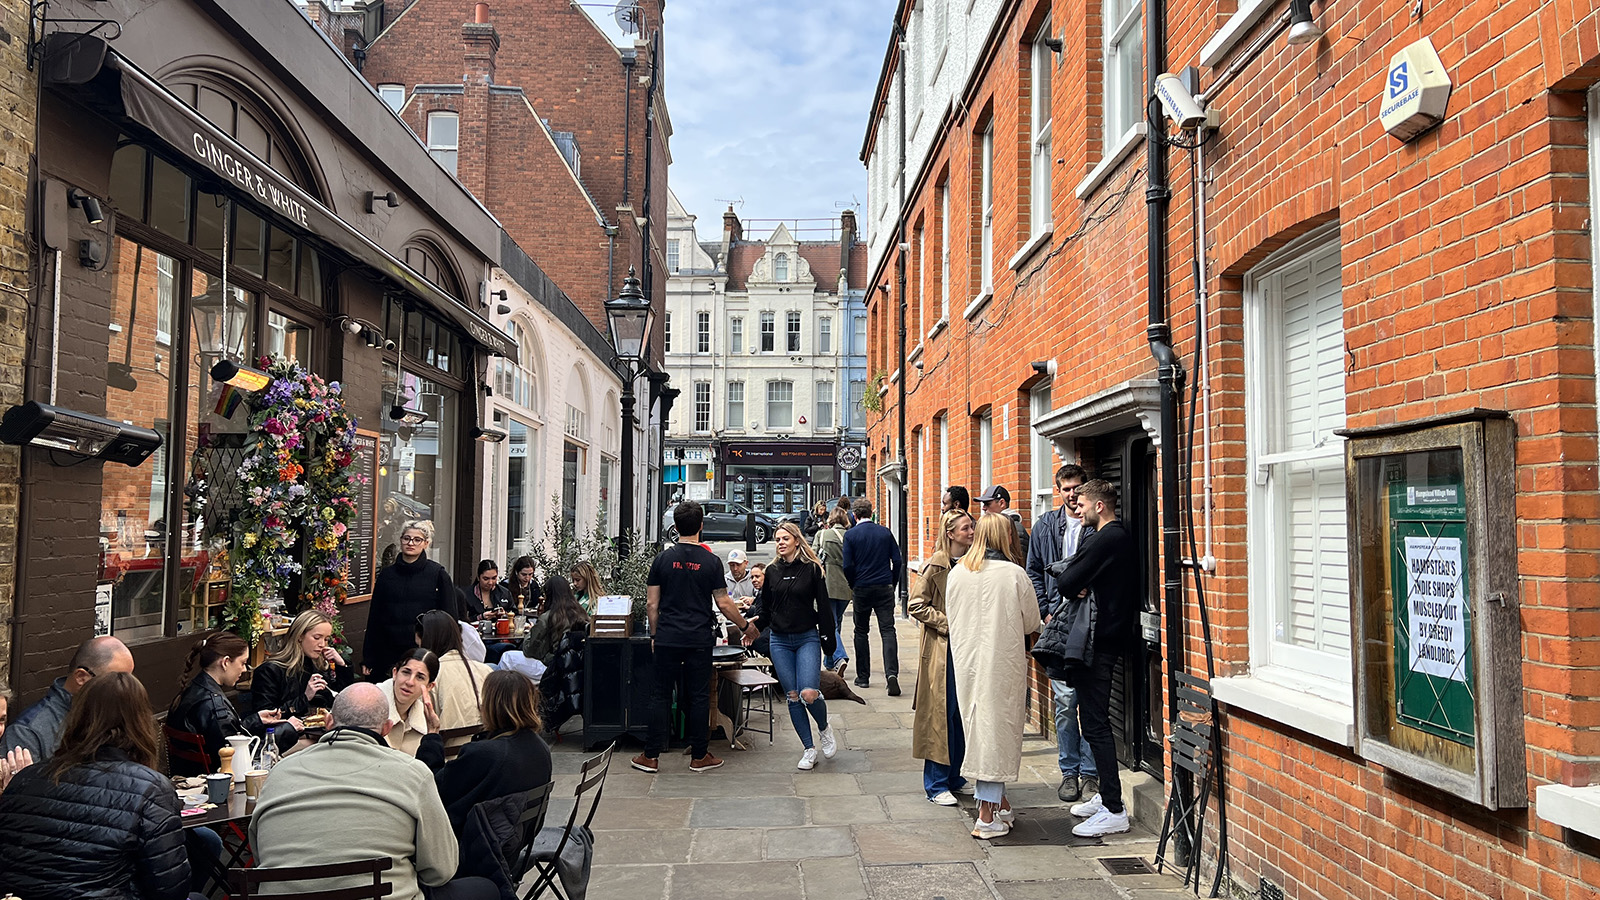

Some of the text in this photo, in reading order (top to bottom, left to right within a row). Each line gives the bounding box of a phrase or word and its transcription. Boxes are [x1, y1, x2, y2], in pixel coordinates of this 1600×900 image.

[1160, 84, 1183, 119] SECUREBASE
[1381, 89, 1419, 119] SECUREBASE
[193, 132, 308, 227] GINGER & WHITE
[665, 451, 702, 459] HTH
[1411, 558, 1456, 577] HAMPSTEAD'S
[1432, 581, 1455, 599] SHOPS
[1413, 600, 1457, 621] MUSCLED OUT
[1419, 622, 1453, 642] BY GREEDY
[1418, 643, 1456, 665] LANDLORDS
